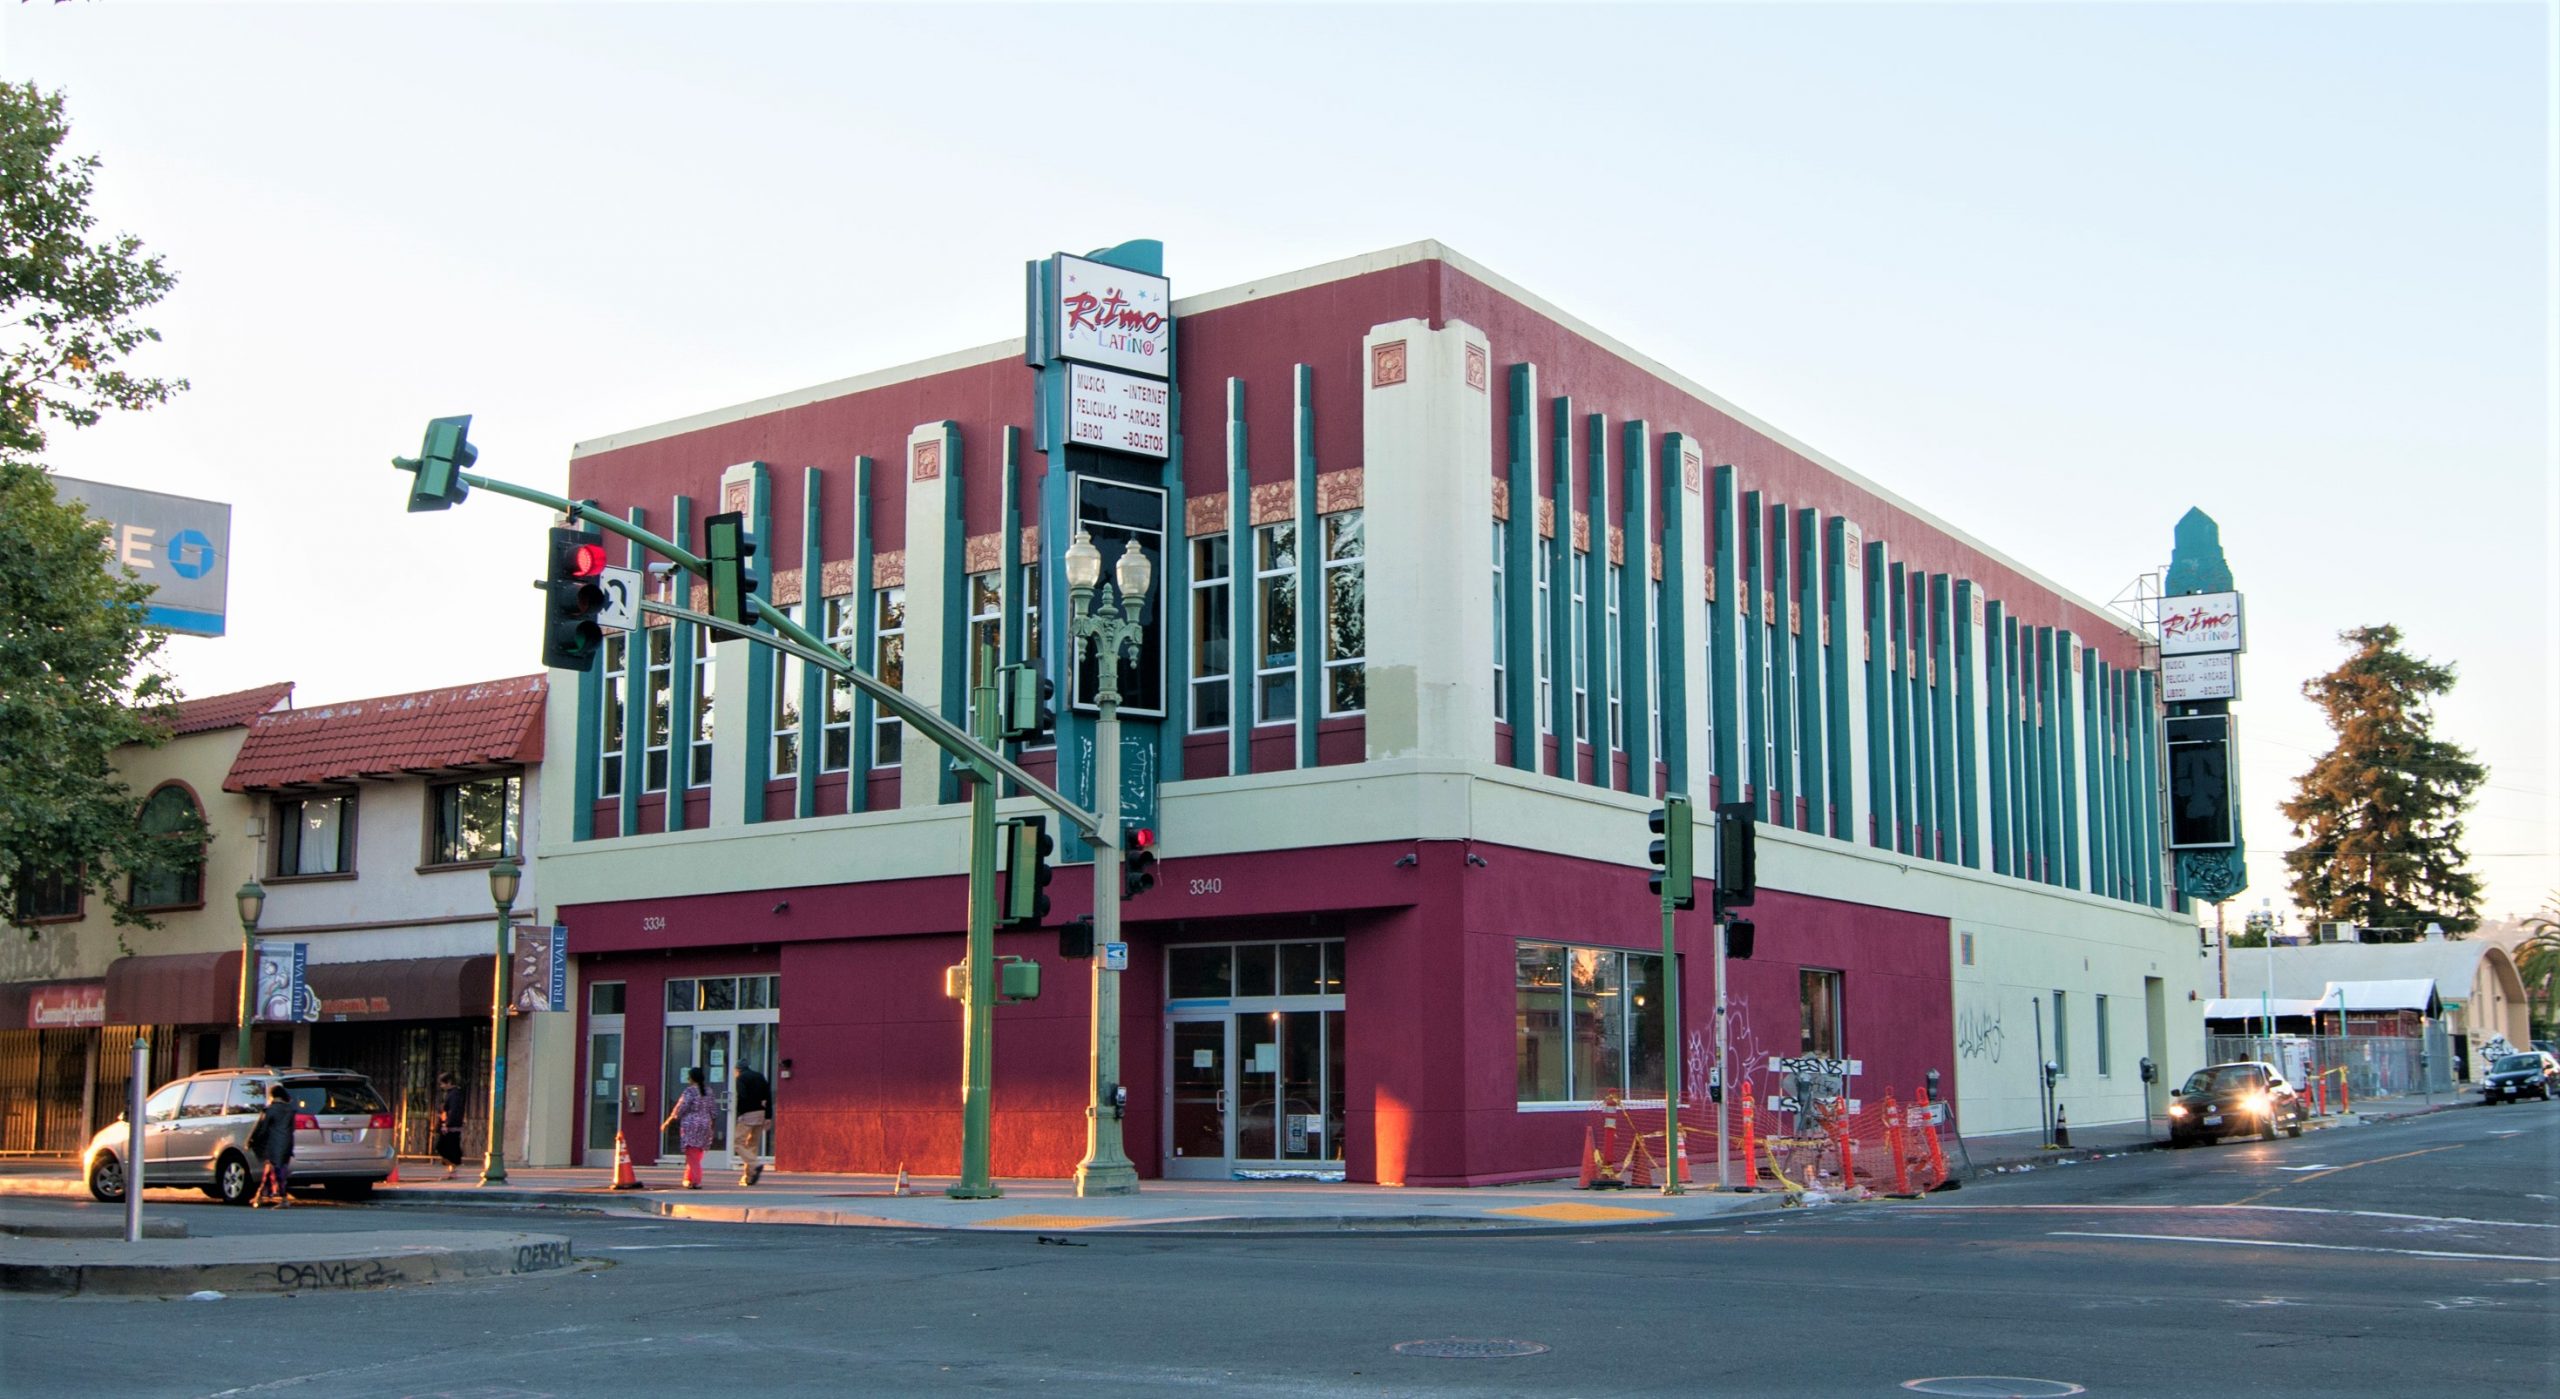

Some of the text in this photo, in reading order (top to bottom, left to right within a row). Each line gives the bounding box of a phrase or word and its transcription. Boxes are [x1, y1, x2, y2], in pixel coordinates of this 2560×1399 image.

[1064, 287, 1167, 334] Ritmo
[1077, 373, 1106, 393] MUSICA
[1076, 398, 1117, 420] PELICULAS
[1076, 421, 1103, 440] LIBROS
[2161, 607, 2238, 638] Ritmo
[1190, 878, 1222, 895] 3340
[643, 916, 666, 931] 3334
[552, 934, 565, 1003] FRUITVALE
[293, 952, 305, 1012] FRUITVALE
